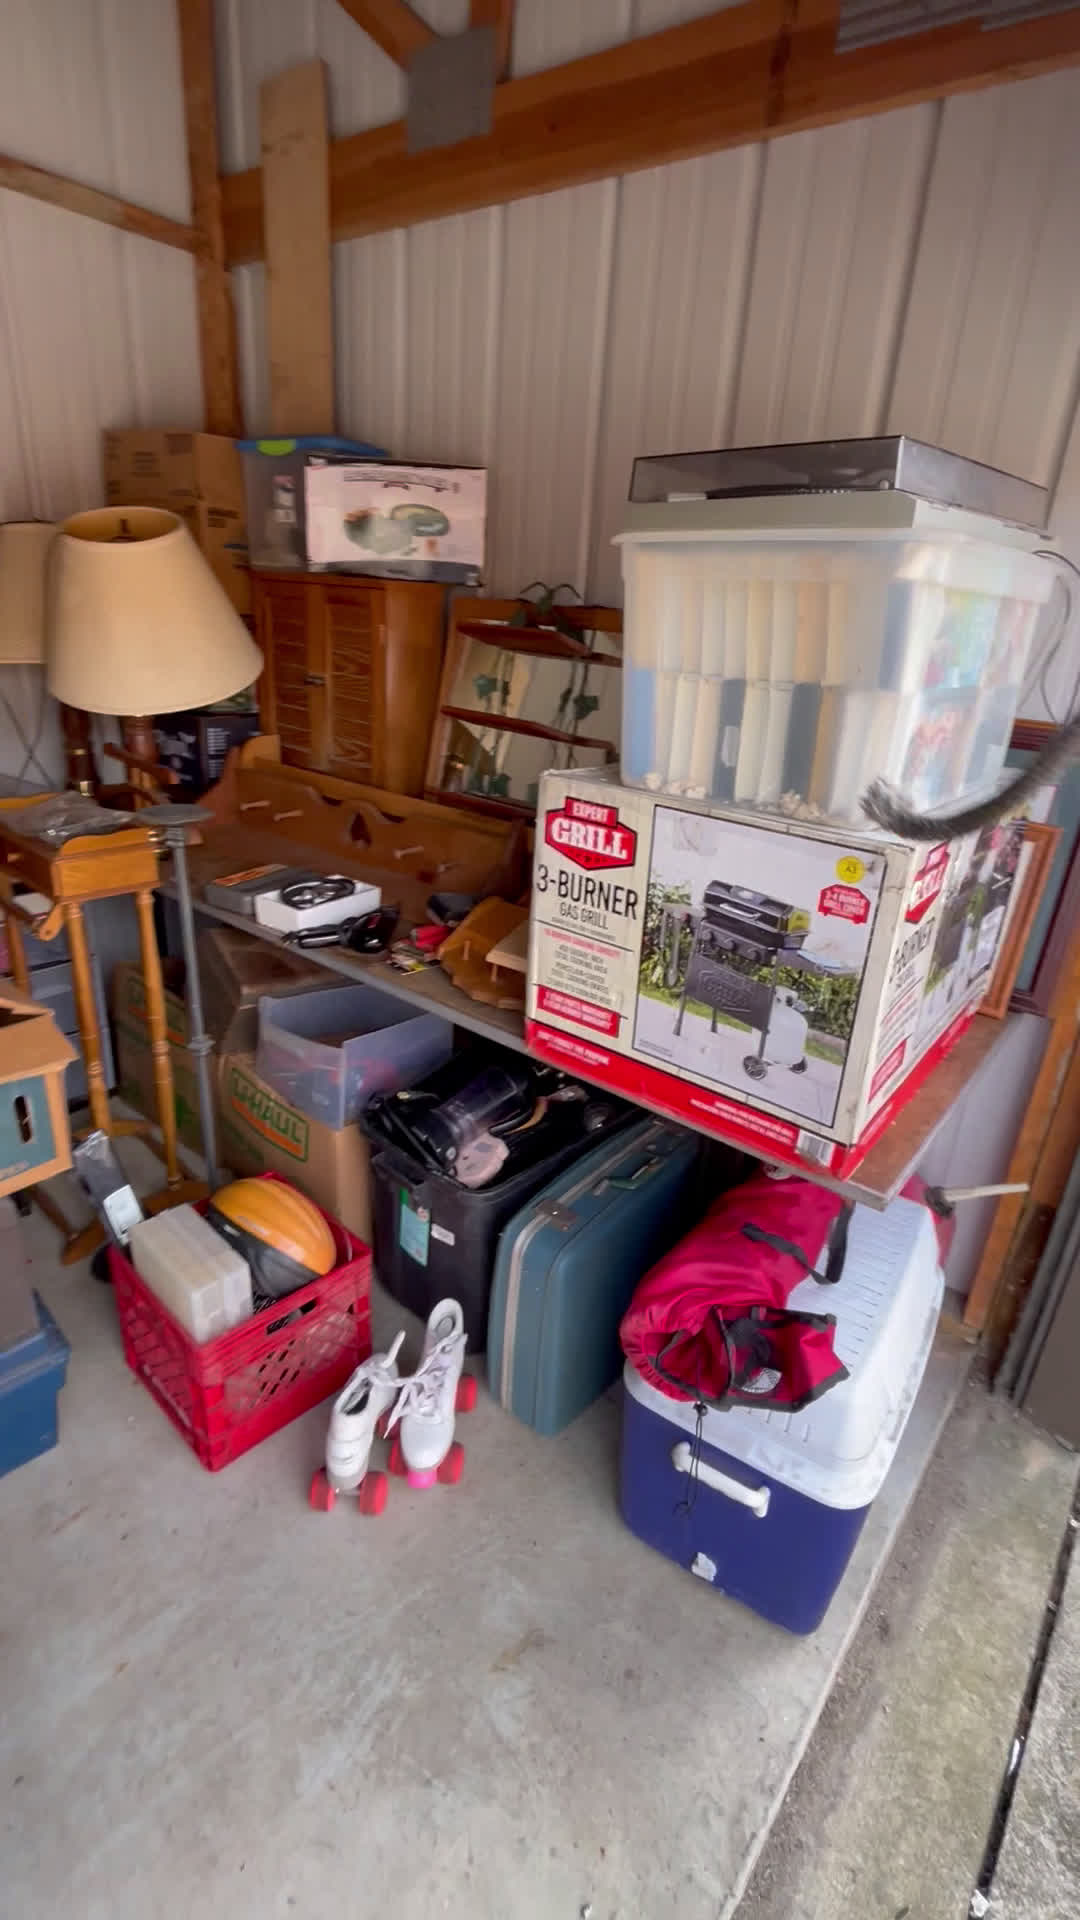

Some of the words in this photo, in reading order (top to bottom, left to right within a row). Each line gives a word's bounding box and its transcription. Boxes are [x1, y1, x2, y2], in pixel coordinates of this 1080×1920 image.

[572, 802, 609, 822] EXPERT
[551, 816, 628, 860] GRILL
[536, 864, 639, 921] 3-BURNER
[559, 902, 579, 920] GAS
[580, 908, 609, 930] GRILL
